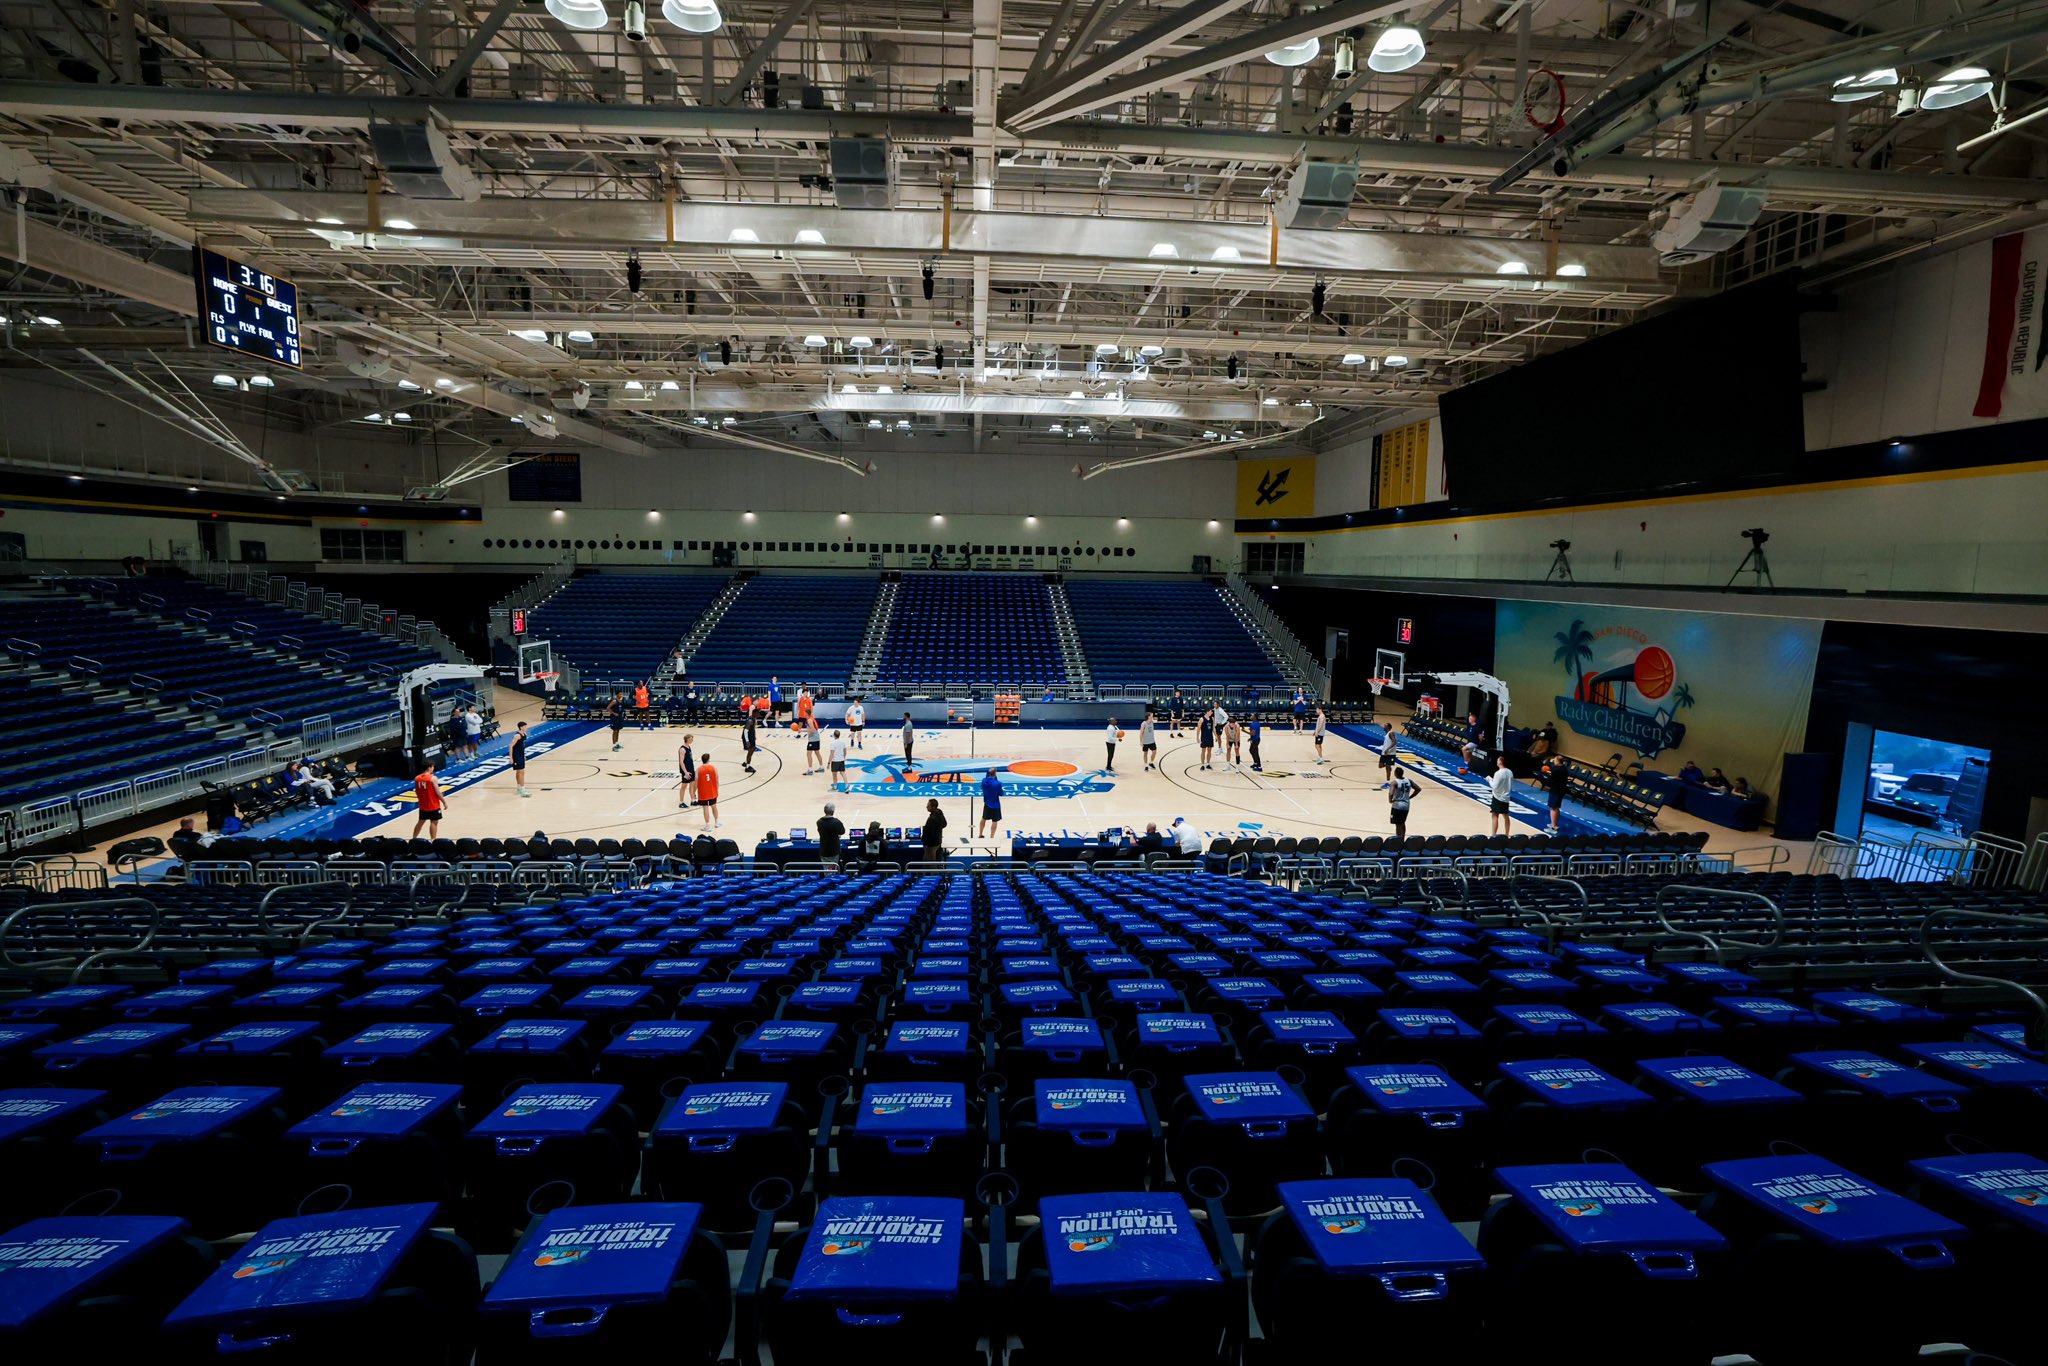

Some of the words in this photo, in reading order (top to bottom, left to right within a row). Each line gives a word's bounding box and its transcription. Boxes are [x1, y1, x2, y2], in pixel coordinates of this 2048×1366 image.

[213, 277, 238, 294] HOME
[240, 265, 274, 295] 3:16
[2019, 261, 2037, 323] CALIFORNIA
[224, 293, 236, 314] 0
[266, 297, 292, 313] GUEST
[210, 312, 225, 324] FLS
[286, 316, 296, 335] 0
[216, 326, 226, 342] 0
[239, 321, 256, 334] PLYR
[258, 327, 275, 340] FOUL
[286, 336, 298, 347] FLS
[290, 350, 299, 364] 0
[2012, 326, 2029, 375] REPUBLIC
[1402, 628, 1411, 640] 30
[1560, 701, 1592, 726] Rady
[1588, 726, 1641, 746] INVITATIONAL
[706, 774, 710, 782] 3
[848, 783, 921, 793] Rady
[1401, 782, 1410, 793] 45
[1370, 1077, 1446, 1085] TRADITION
[1202, 1084, 1280, 1095] TRADITION
[342, 1098, 432, 1106] TRADITION
[686, 1095, 770, 1105] TRADITION
[1538, 1186, 1653, 1200] TRADITION
[1761, 1177, 1866, 1199] TRADITION
[1307, 1200, 1422, 1216] TRADITION
[822, 1222, 943, 1237] TRADITION
[1060, 1215, 1178, 1234] TRADITION
[1120, 1228, 1167, 1236] HOLIDAY
[247, 1231, 396, 1258] TRADITION
[540, 1228, 672, 1247] TRADITION
[307, 1245, 370, 1257] HOLIDAY
[598, 1241, 650, 1251] HOLIDAY
